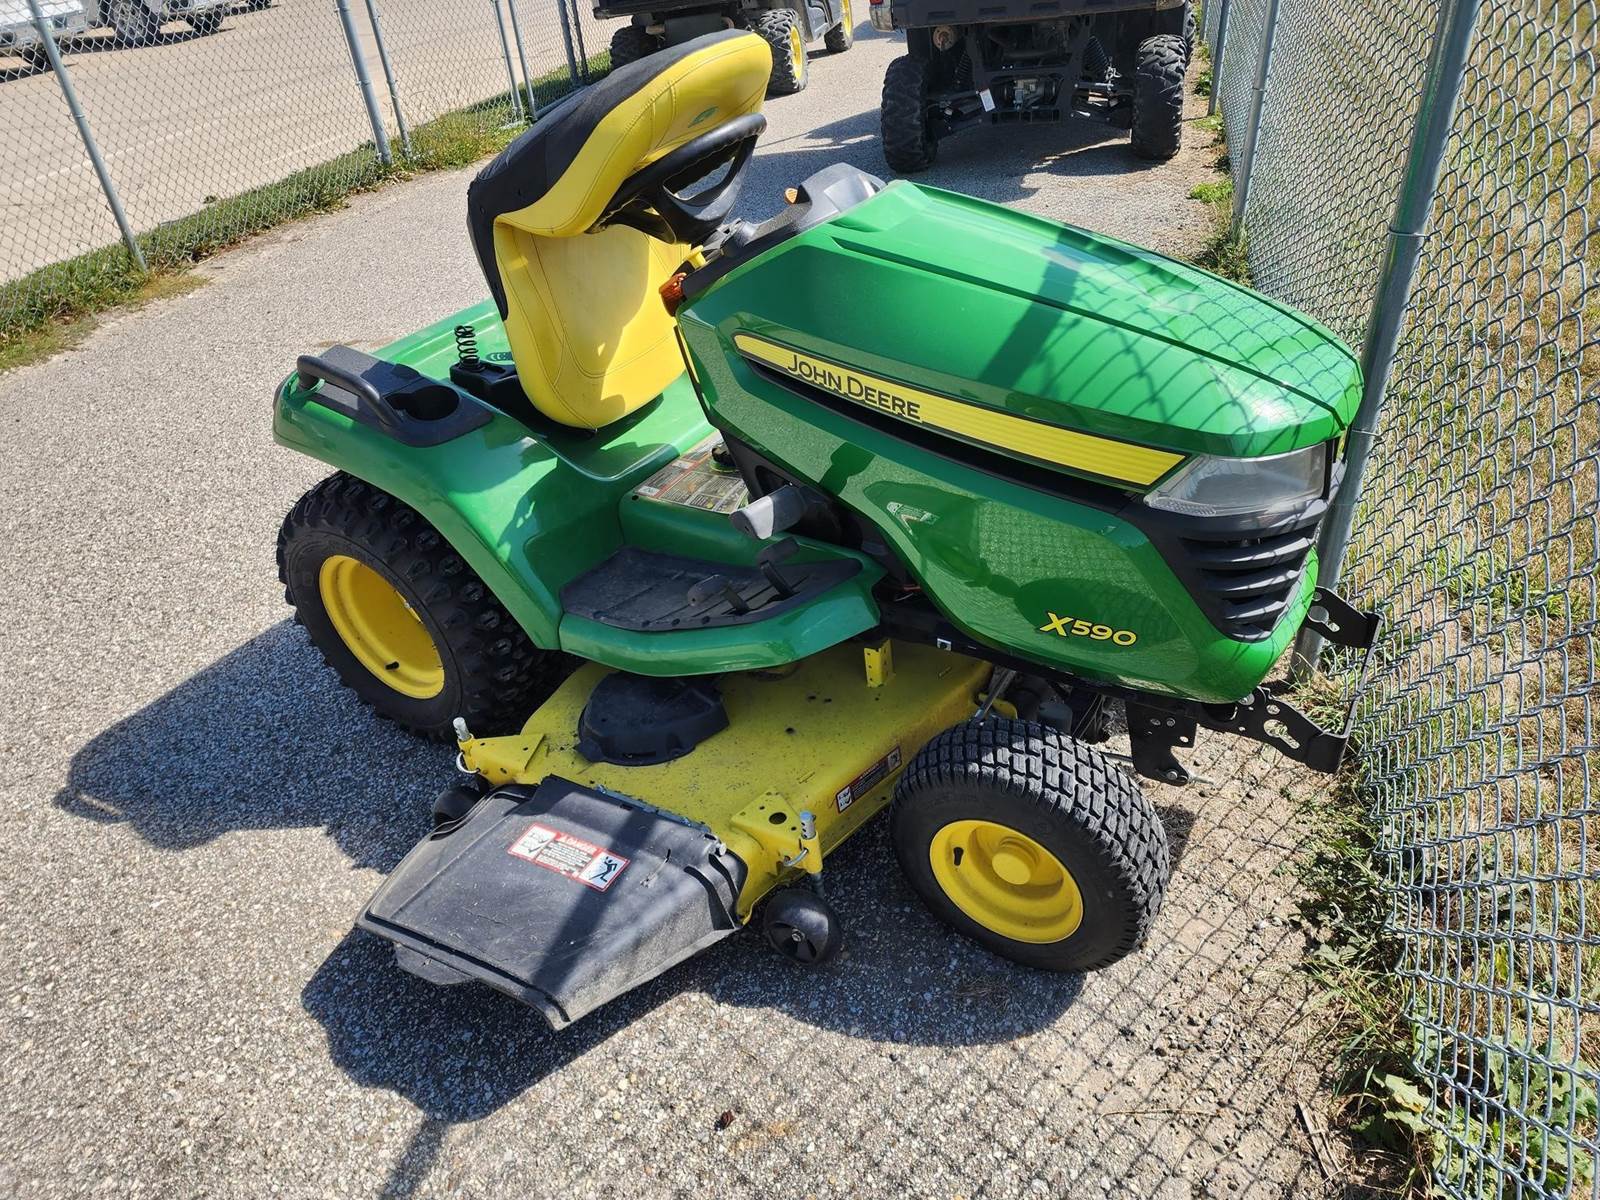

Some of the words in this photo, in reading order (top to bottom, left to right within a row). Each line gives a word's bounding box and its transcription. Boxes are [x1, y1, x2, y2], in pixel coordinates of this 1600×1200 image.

[788, 354, 841, 391] JOHN
[847, 375, 921, 420] DEERE
[1039, 612, 1137, 646] X590
